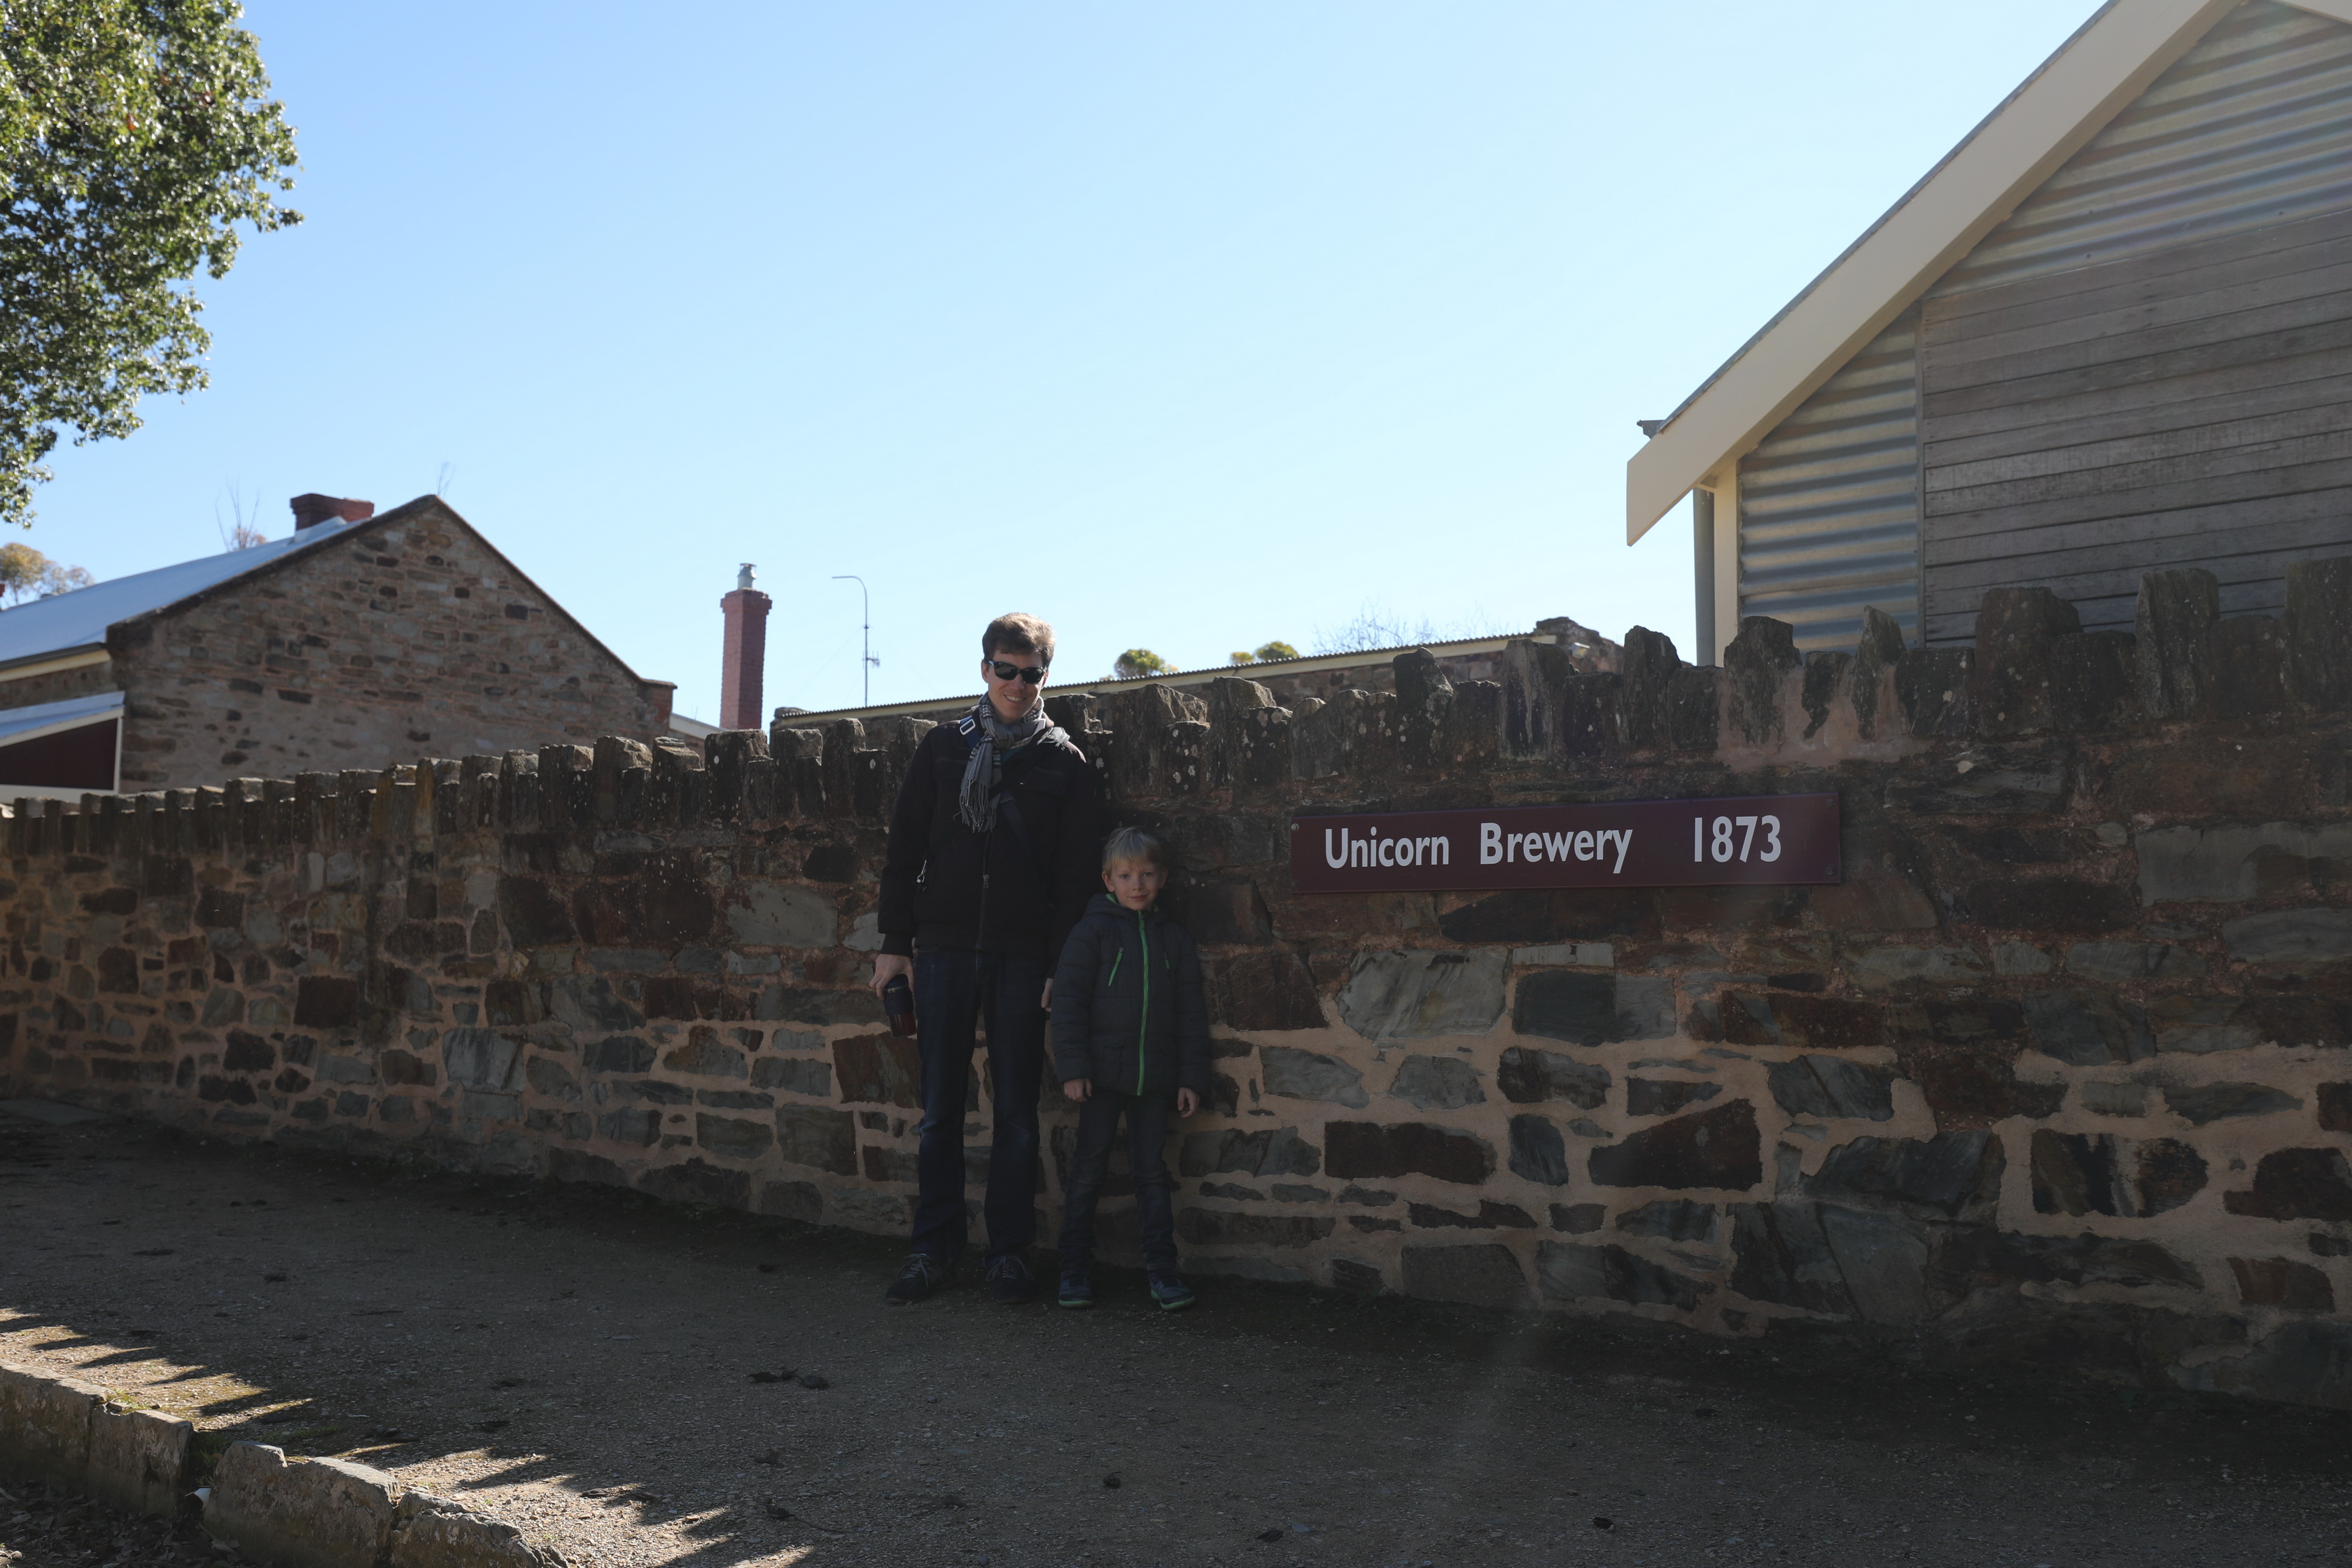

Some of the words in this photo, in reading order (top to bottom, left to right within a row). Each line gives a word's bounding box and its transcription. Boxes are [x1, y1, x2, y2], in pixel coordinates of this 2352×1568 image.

[1325, 827, 1449, 869] Unicorn
[1480, 822, 1633, 874] Brewery
[1694, 815, 1782, 863] 1873
